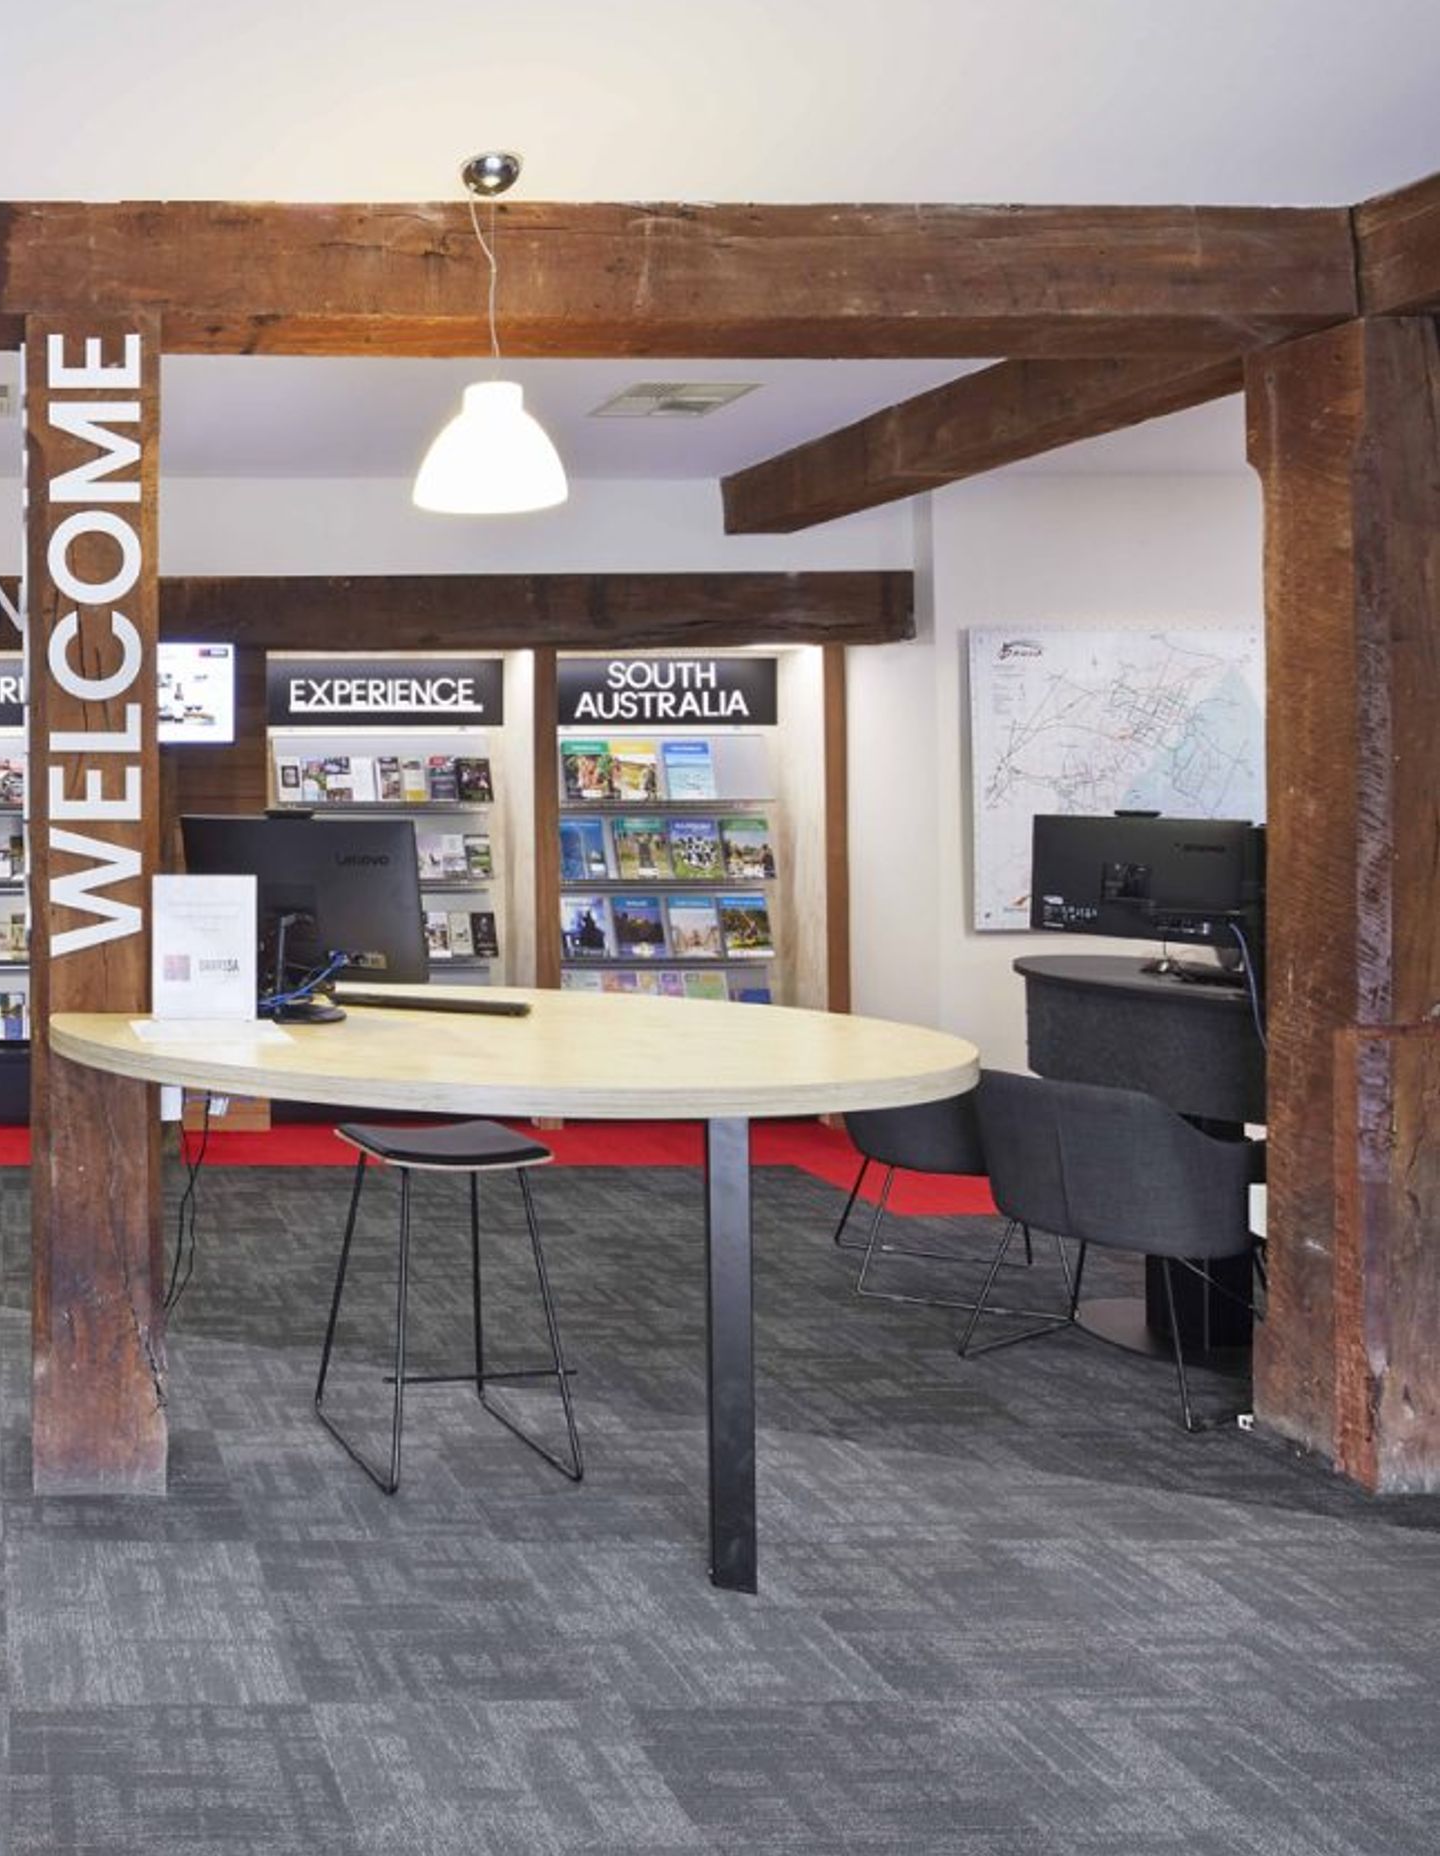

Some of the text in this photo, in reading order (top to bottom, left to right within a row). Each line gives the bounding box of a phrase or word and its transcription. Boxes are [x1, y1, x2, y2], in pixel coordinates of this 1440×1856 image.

[47, 334, 142, 957] WELCOME
[606, 660, 717, 689] SOUTH
[289, 677, 476, 706] EXPERIENCE
[574, 690, 750, 719] AUSTRALIA
